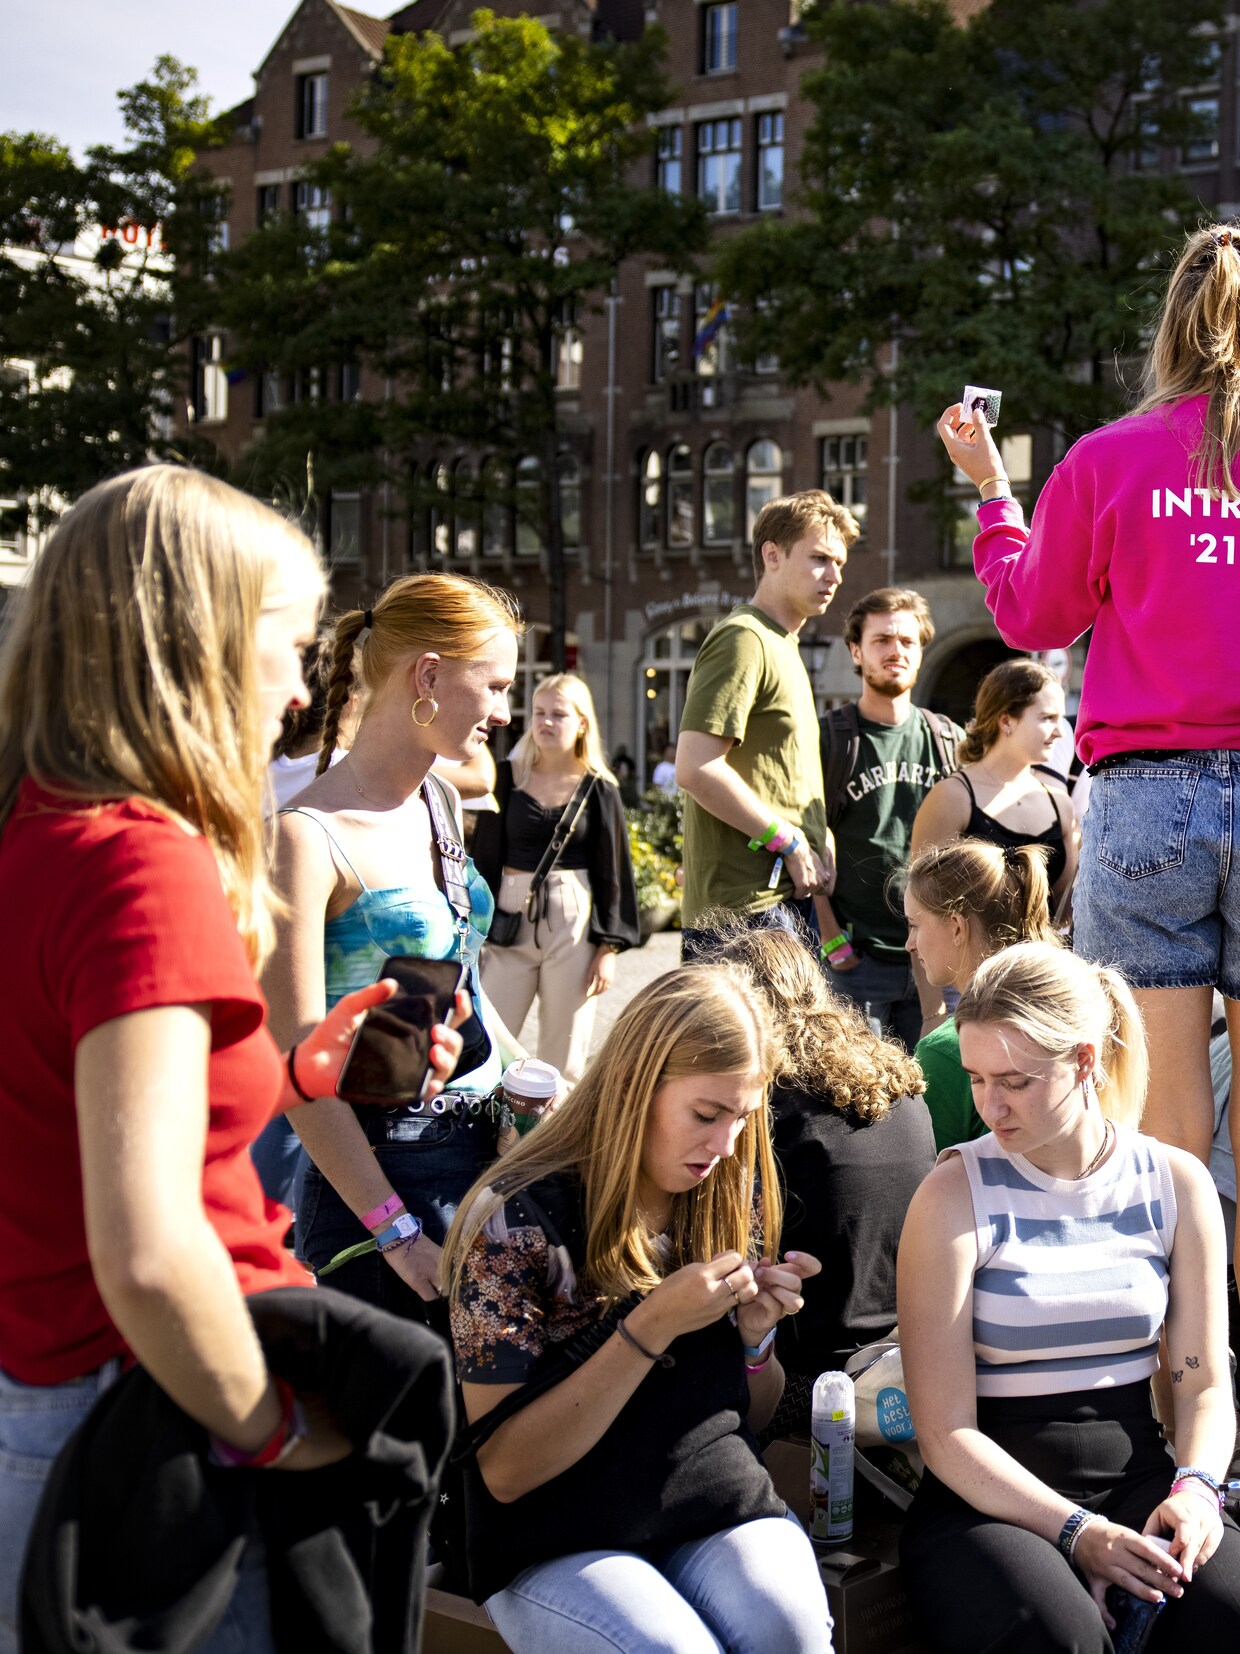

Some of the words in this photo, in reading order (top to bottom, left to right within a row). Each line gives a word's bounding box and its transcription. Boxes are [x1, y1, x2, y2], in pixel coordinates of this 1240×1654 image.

[846, 760, 940, 801] CARHART
[505, 1096, 526, 1107] CCINO
[882, 1394, 901, 1409] Het
[883, 1406, 911, 1424] best
[885, 1422, 905, 1438] voor
